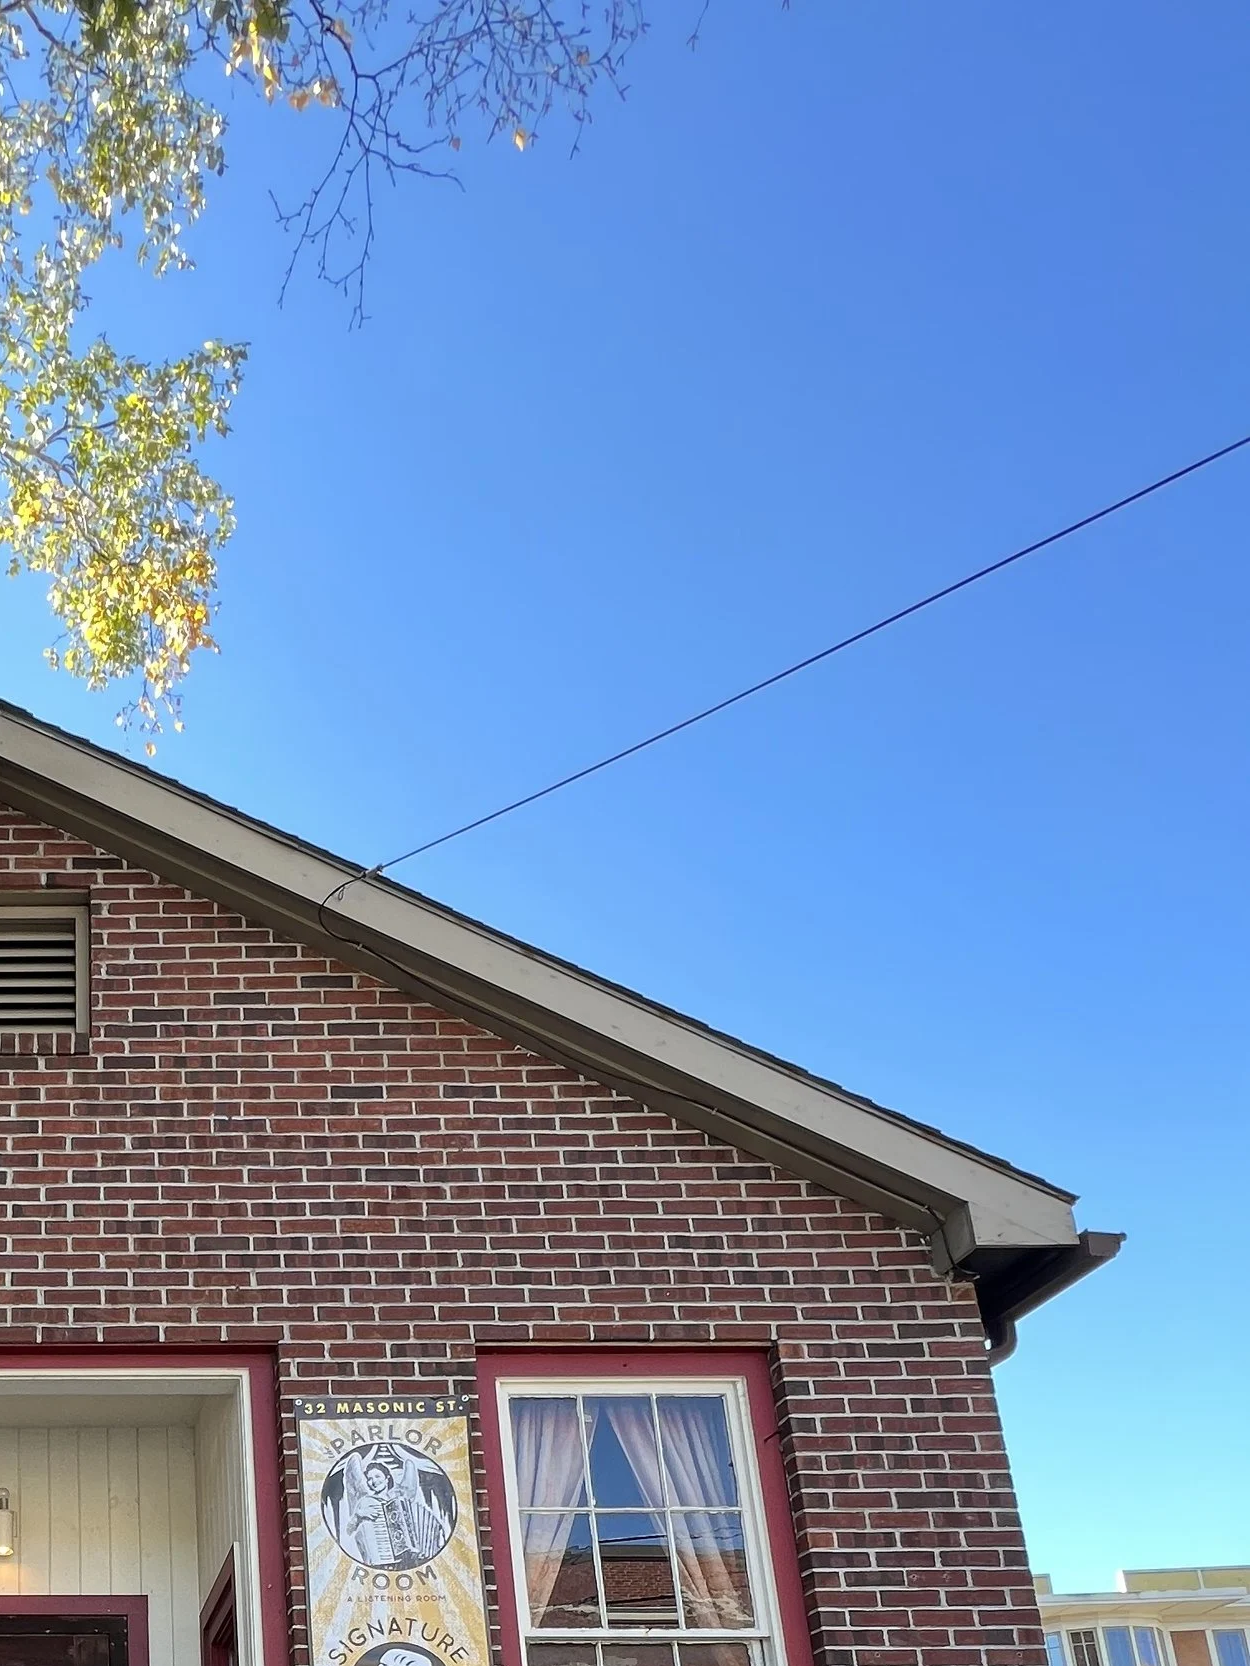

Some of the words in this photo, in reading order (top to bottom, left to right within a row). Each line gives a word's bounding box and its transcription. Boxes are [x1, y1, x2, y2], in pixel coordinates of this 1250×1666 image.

[304, 1402, 326, 1414] 32
[336, 1401, 426, 1414] MASONIC
[435, 1400, 464, 1412] ST.
[329, 1424, 443, 1456] PARLOR
[351, 1564, 438, 1591] ROOM
[347, 1595, 353, 1603] A
[358, 1594, 411, 1603] LISTENING
[416, 1594, 446, 1602] ROOM
[328, 1616, 470, 1666] SIGNATURE
